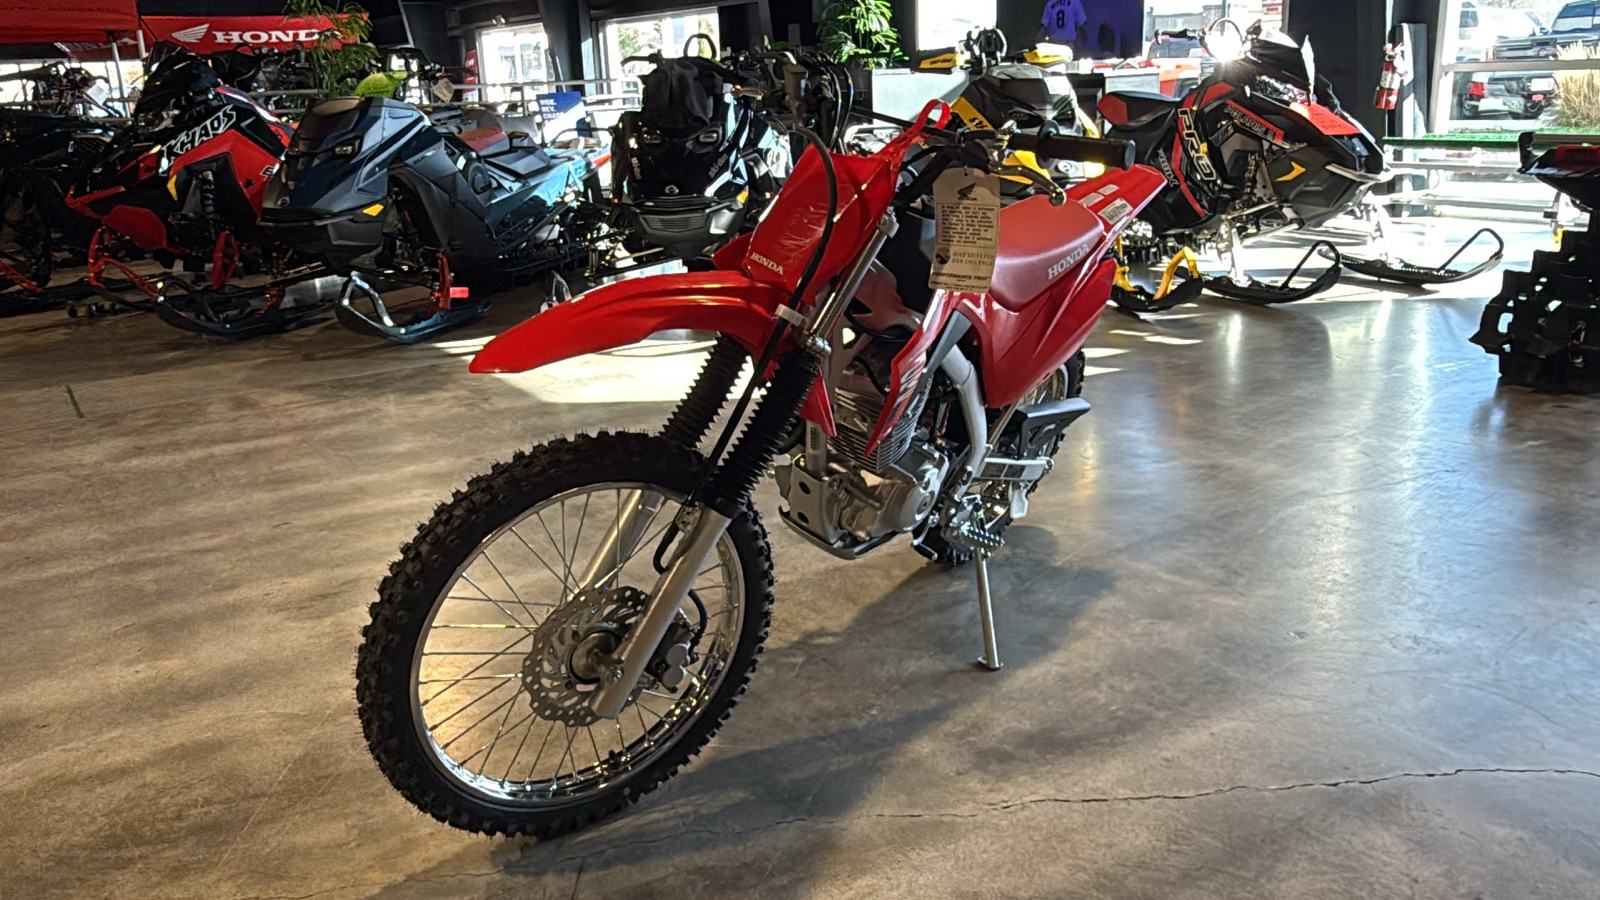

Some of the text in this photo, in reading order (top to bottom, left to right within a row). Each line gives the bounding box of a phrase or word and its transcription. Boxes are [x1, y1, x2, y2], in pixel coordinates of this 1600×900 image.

[1056, 10, 1065, 29] 8
[1224, 105, 1266, 135] POLARIS
[158, 103, 237, 176] KHAOS
[1177, 107, 1216, 180] PRO
[750, 251, 784, 276] HONDA
[1047, 243, 1091, 280] HONDA
